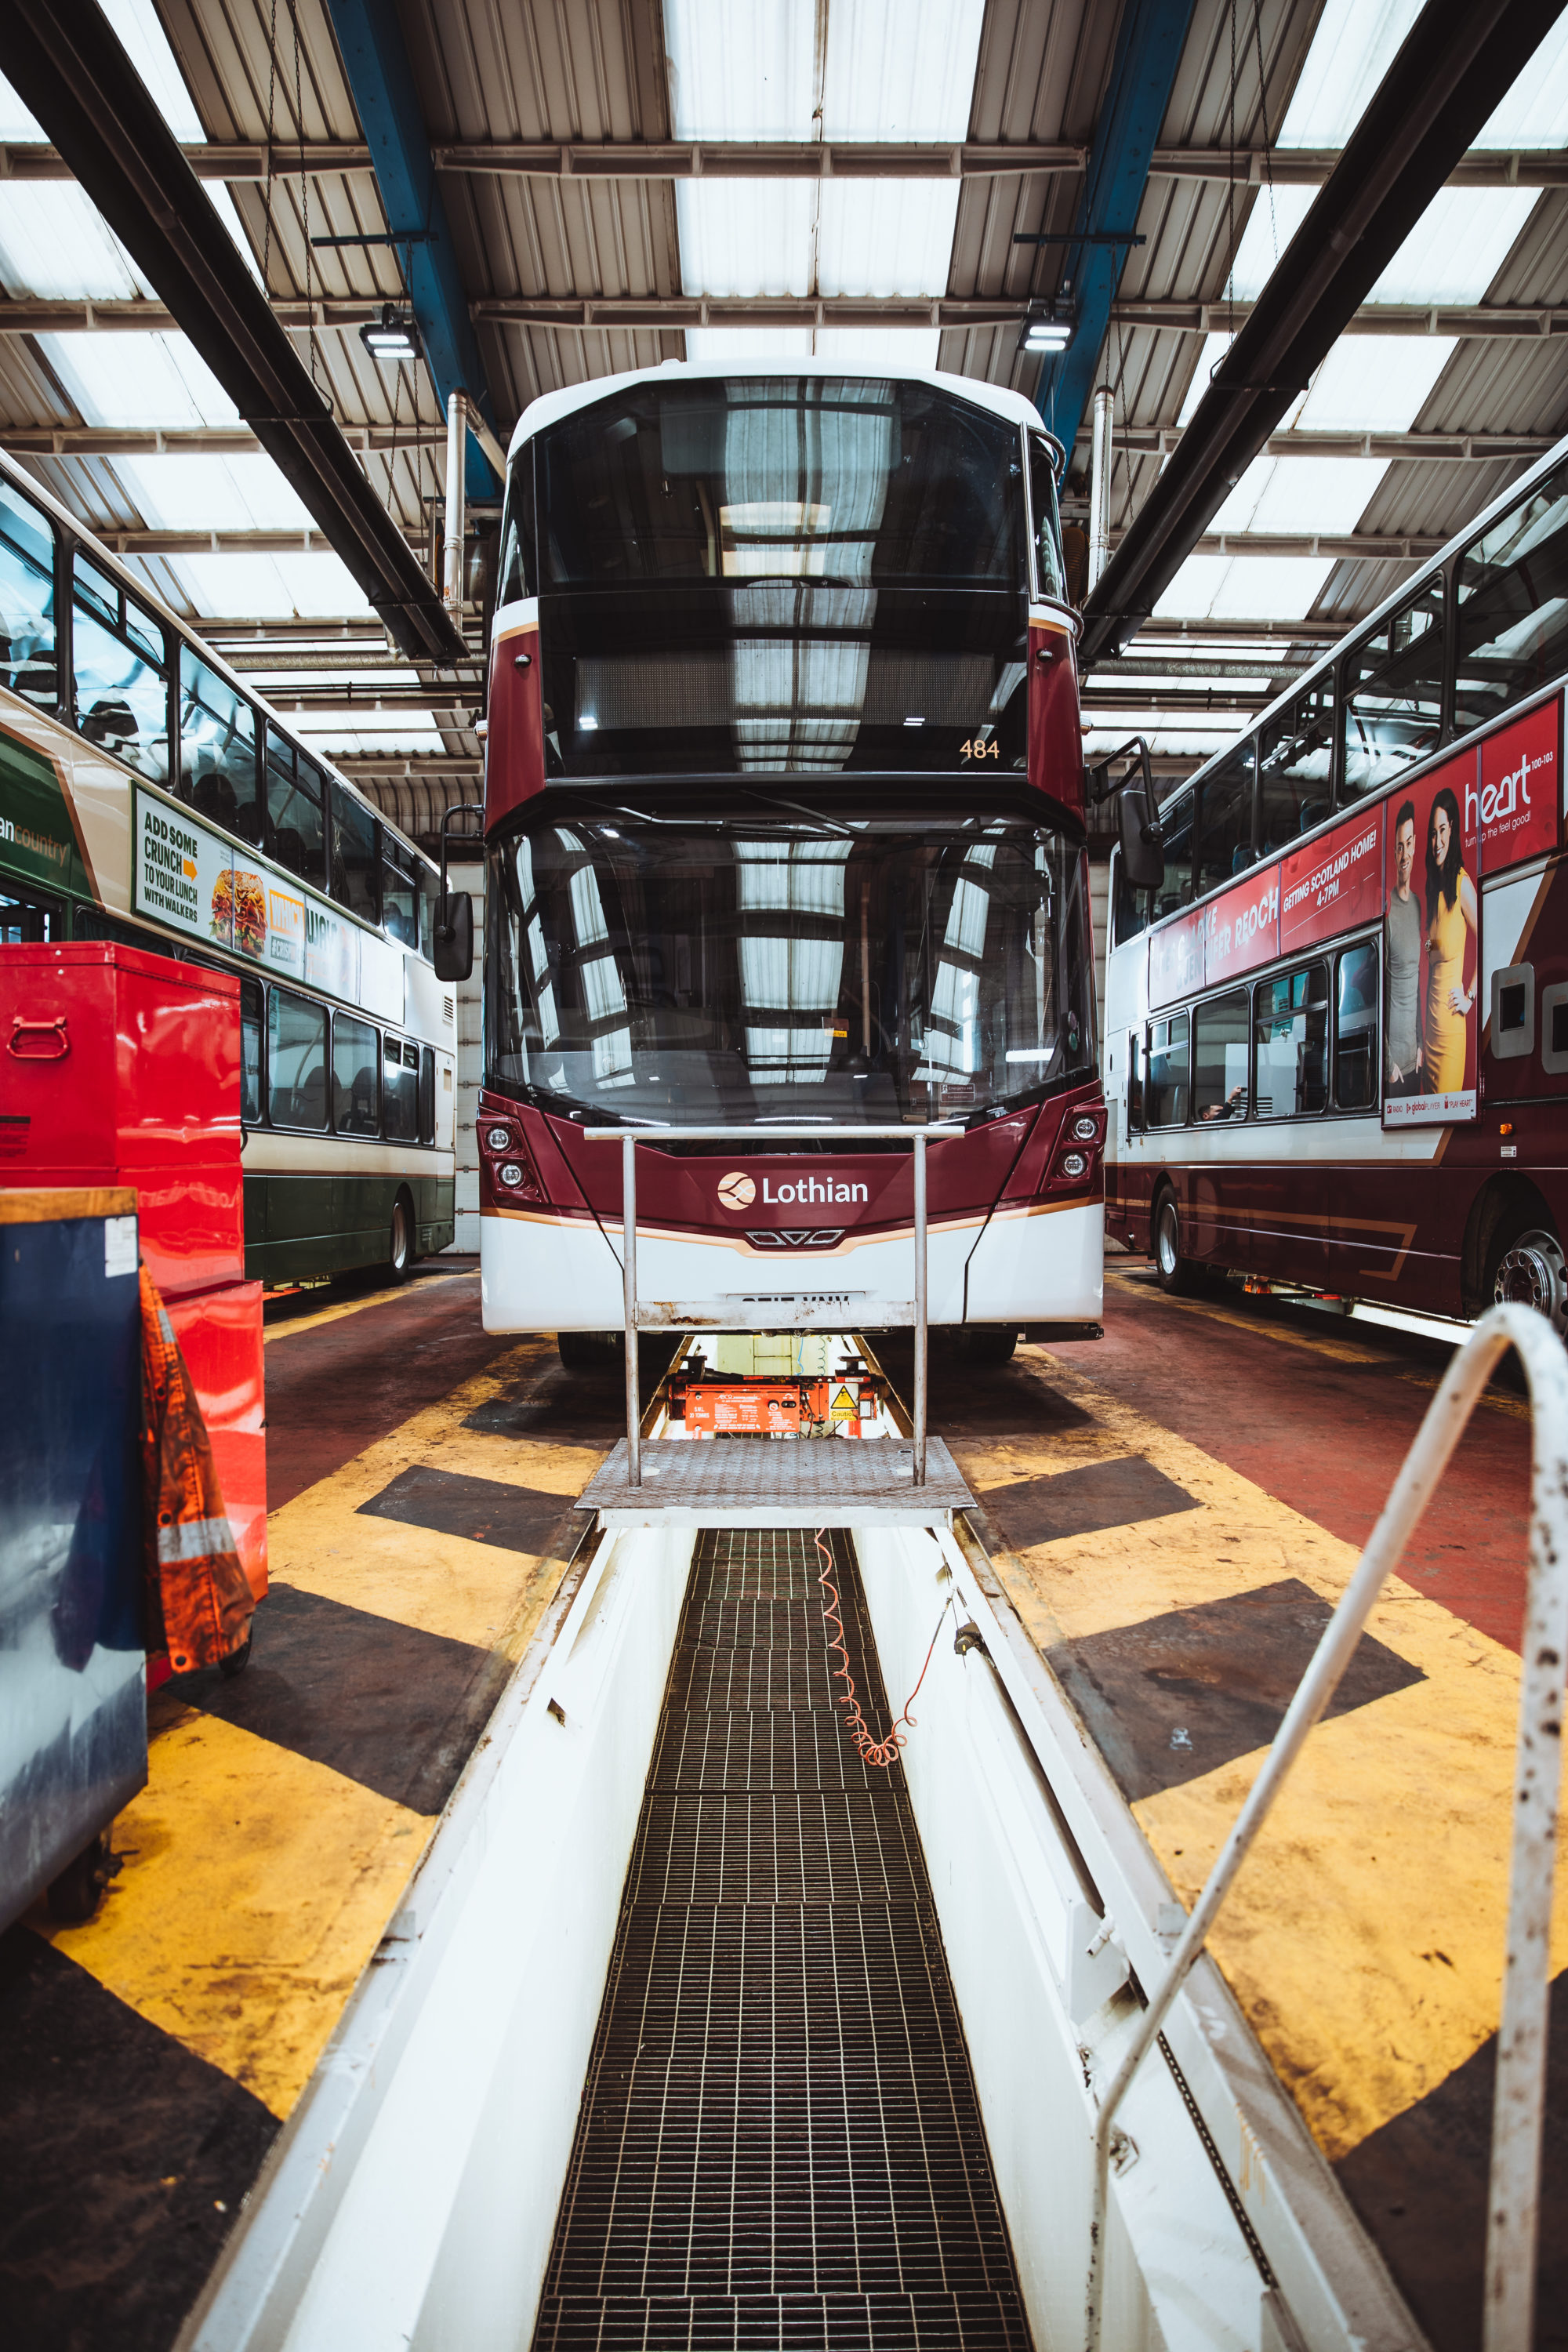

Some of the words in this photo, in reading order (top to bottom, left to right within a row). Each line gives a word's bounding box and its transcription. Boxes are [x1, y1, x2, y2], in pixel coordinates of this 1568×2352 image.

[959, 739, 1000, 759] 484
[1465, 753, 1531, 833] heart
[1531, 751, 1553, 770] 100-103
[144, 811, 168, 840] ADD
[169, 826, 198, 858] SOME
[1465, 835, 1476, 848] turn
[1487, 826, 1497, 839] the
[1499, 818, 1511, 834] feel
[1512, 810, 1531, 831] good!
[144, 836, 183, 876] CRUNCH
[1283, 880, 1310, 913] GETTING
[1310, 851, 1349, 893] SCOTLAND
[1350, 829, 1377, 864] HOME!
[144, 862, 154, 884] TO
[155, 869, 175, 895] YOUR
[175, 880, 198, 906] LUNCH
[1316, 878, 1340, 907] 4-7PM
[144, 886, 164, 908] WITH
[165, 896, 198, 923] WALKERS
[1235, 887, 1278, 949] REOCH
[1392, 1105, 1403, 1113] RADIO
[763, 1176, 868, 1203] Lothian
